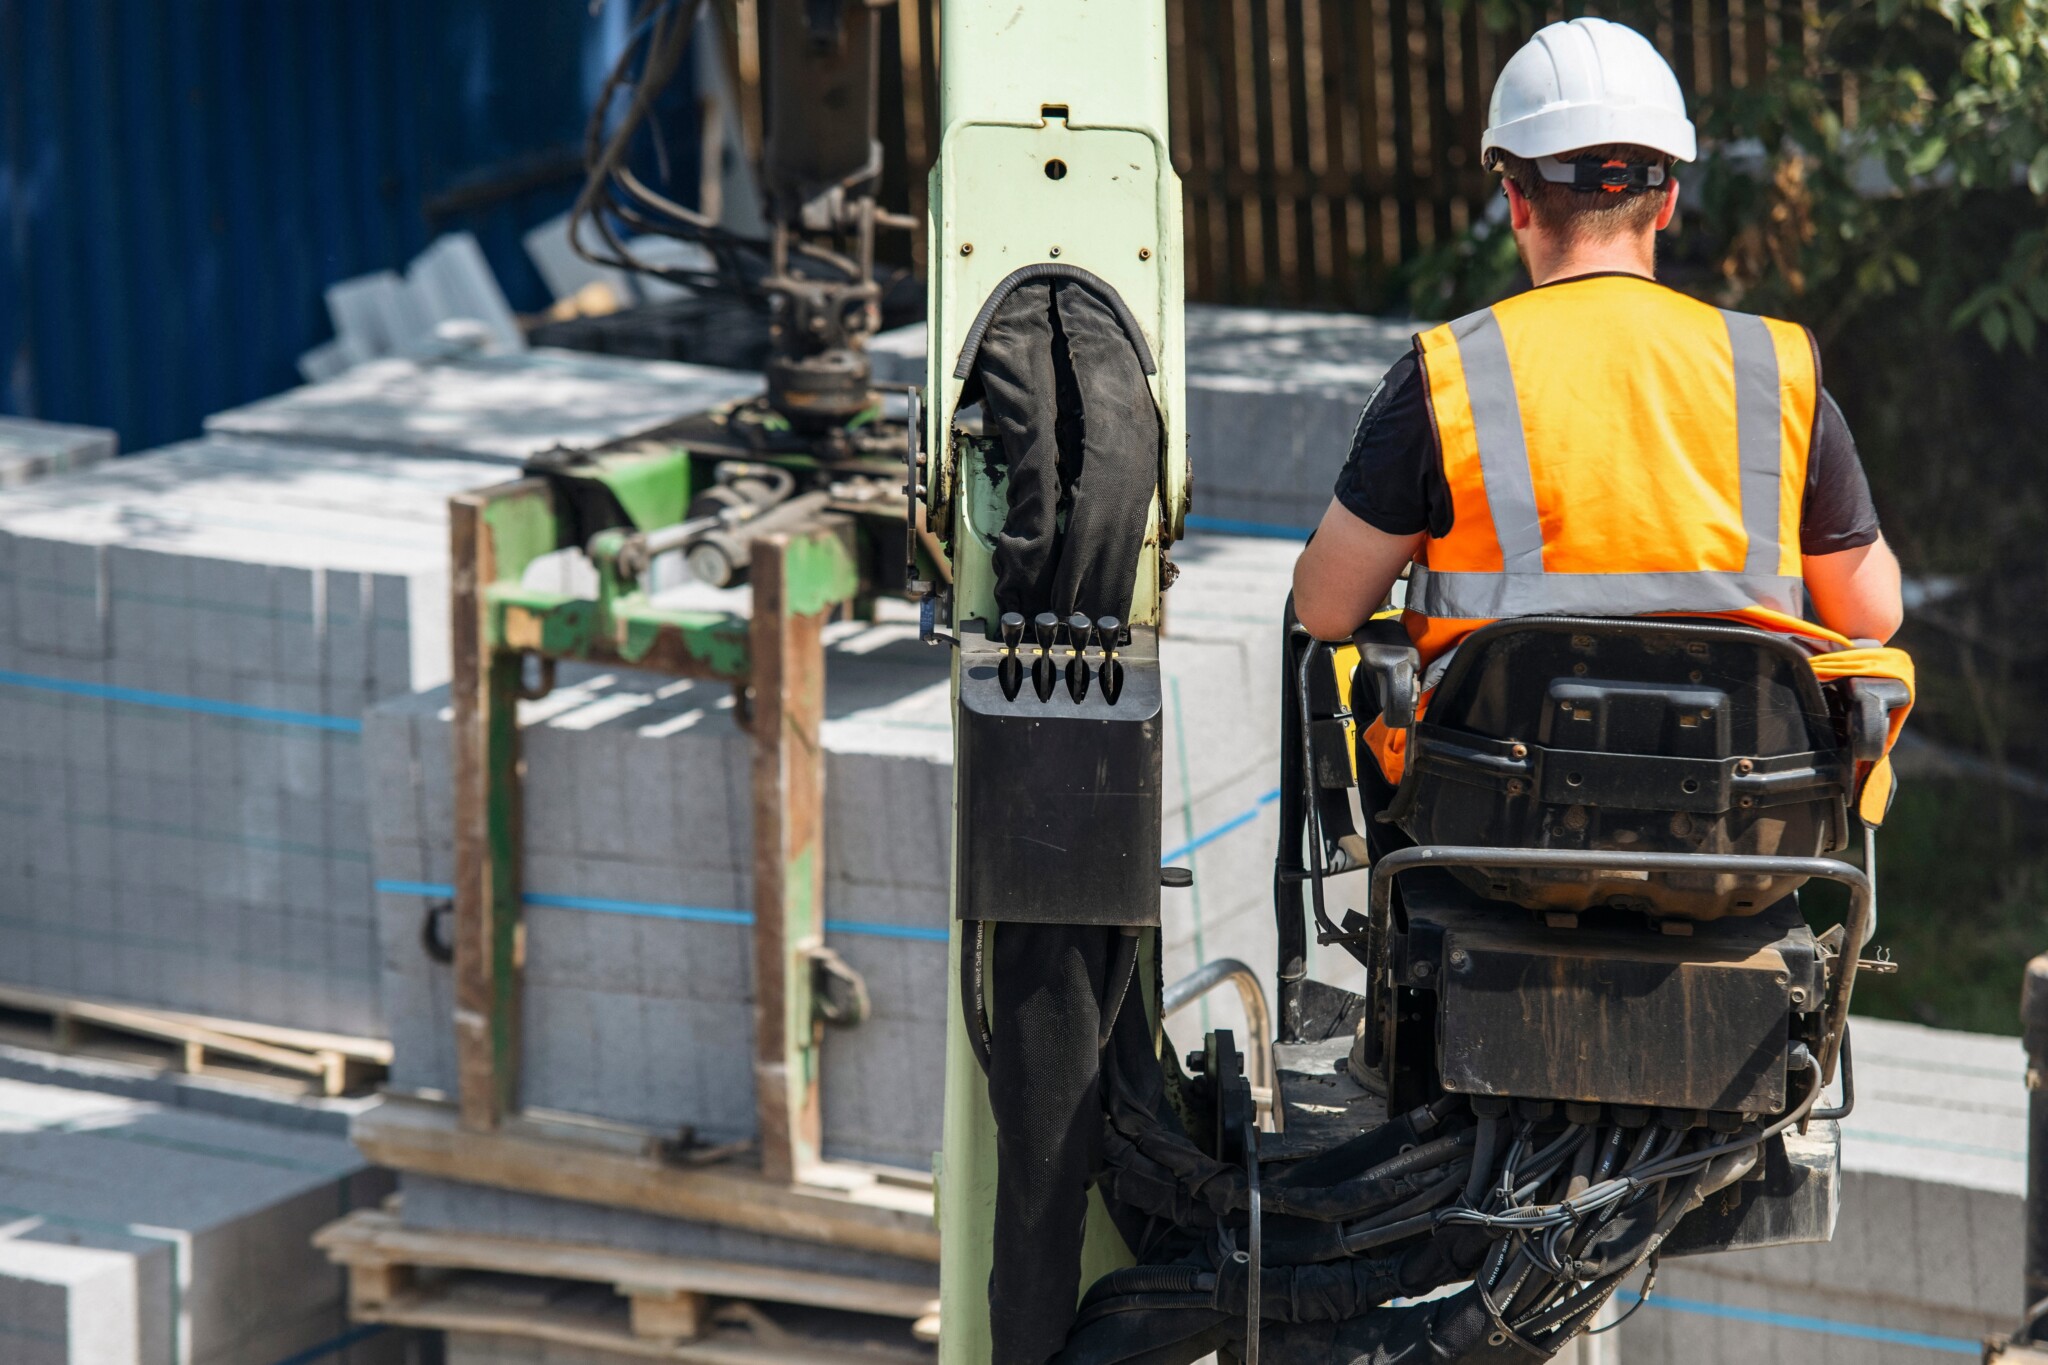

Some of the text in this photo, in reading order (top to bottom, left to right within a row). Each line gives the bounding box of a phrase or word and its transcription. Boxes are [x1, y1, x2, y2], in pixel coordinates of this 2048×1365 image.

[1389, 1156, 1412, 1170] SHPLS
[1496, 1253, 1505, 1266] WP
[1511, 1281, 1522, 1294] WP
